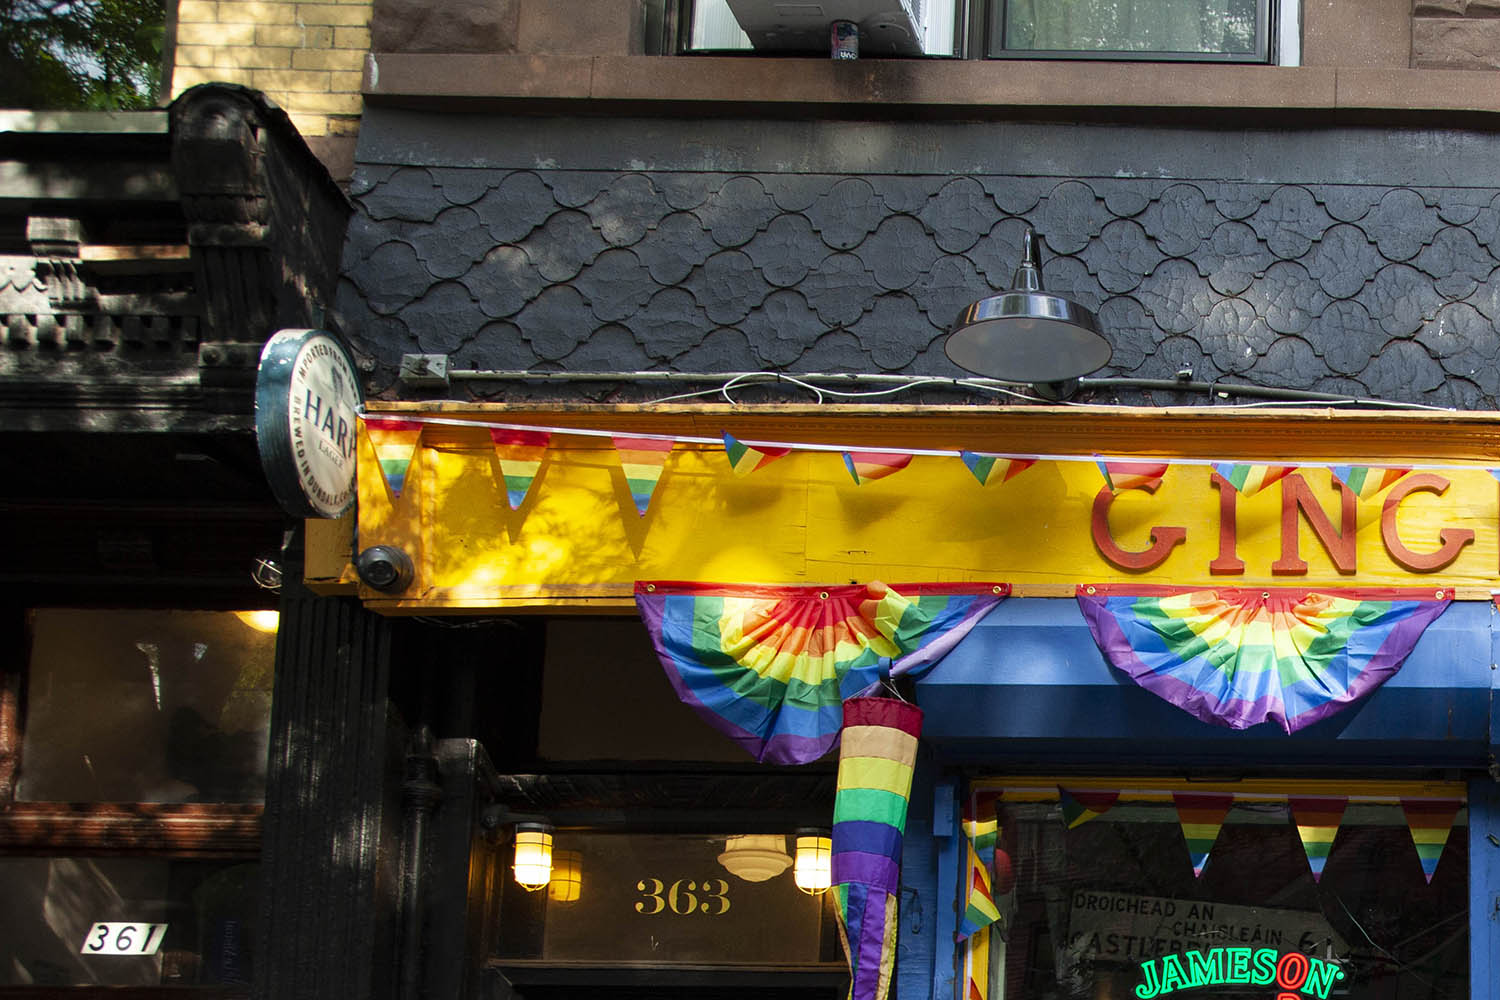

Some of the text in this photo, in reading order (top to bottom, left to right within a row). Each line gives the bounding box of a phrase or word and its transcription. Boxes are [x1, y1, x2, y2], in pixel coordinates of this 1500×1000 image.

[634, 878, 731, 915] 363
[1073, 892, 1215, 921] DROICHEAD AN
[89, 924, 157, 952] 361
[1135, 947, 1340, 1000] JAMESON
